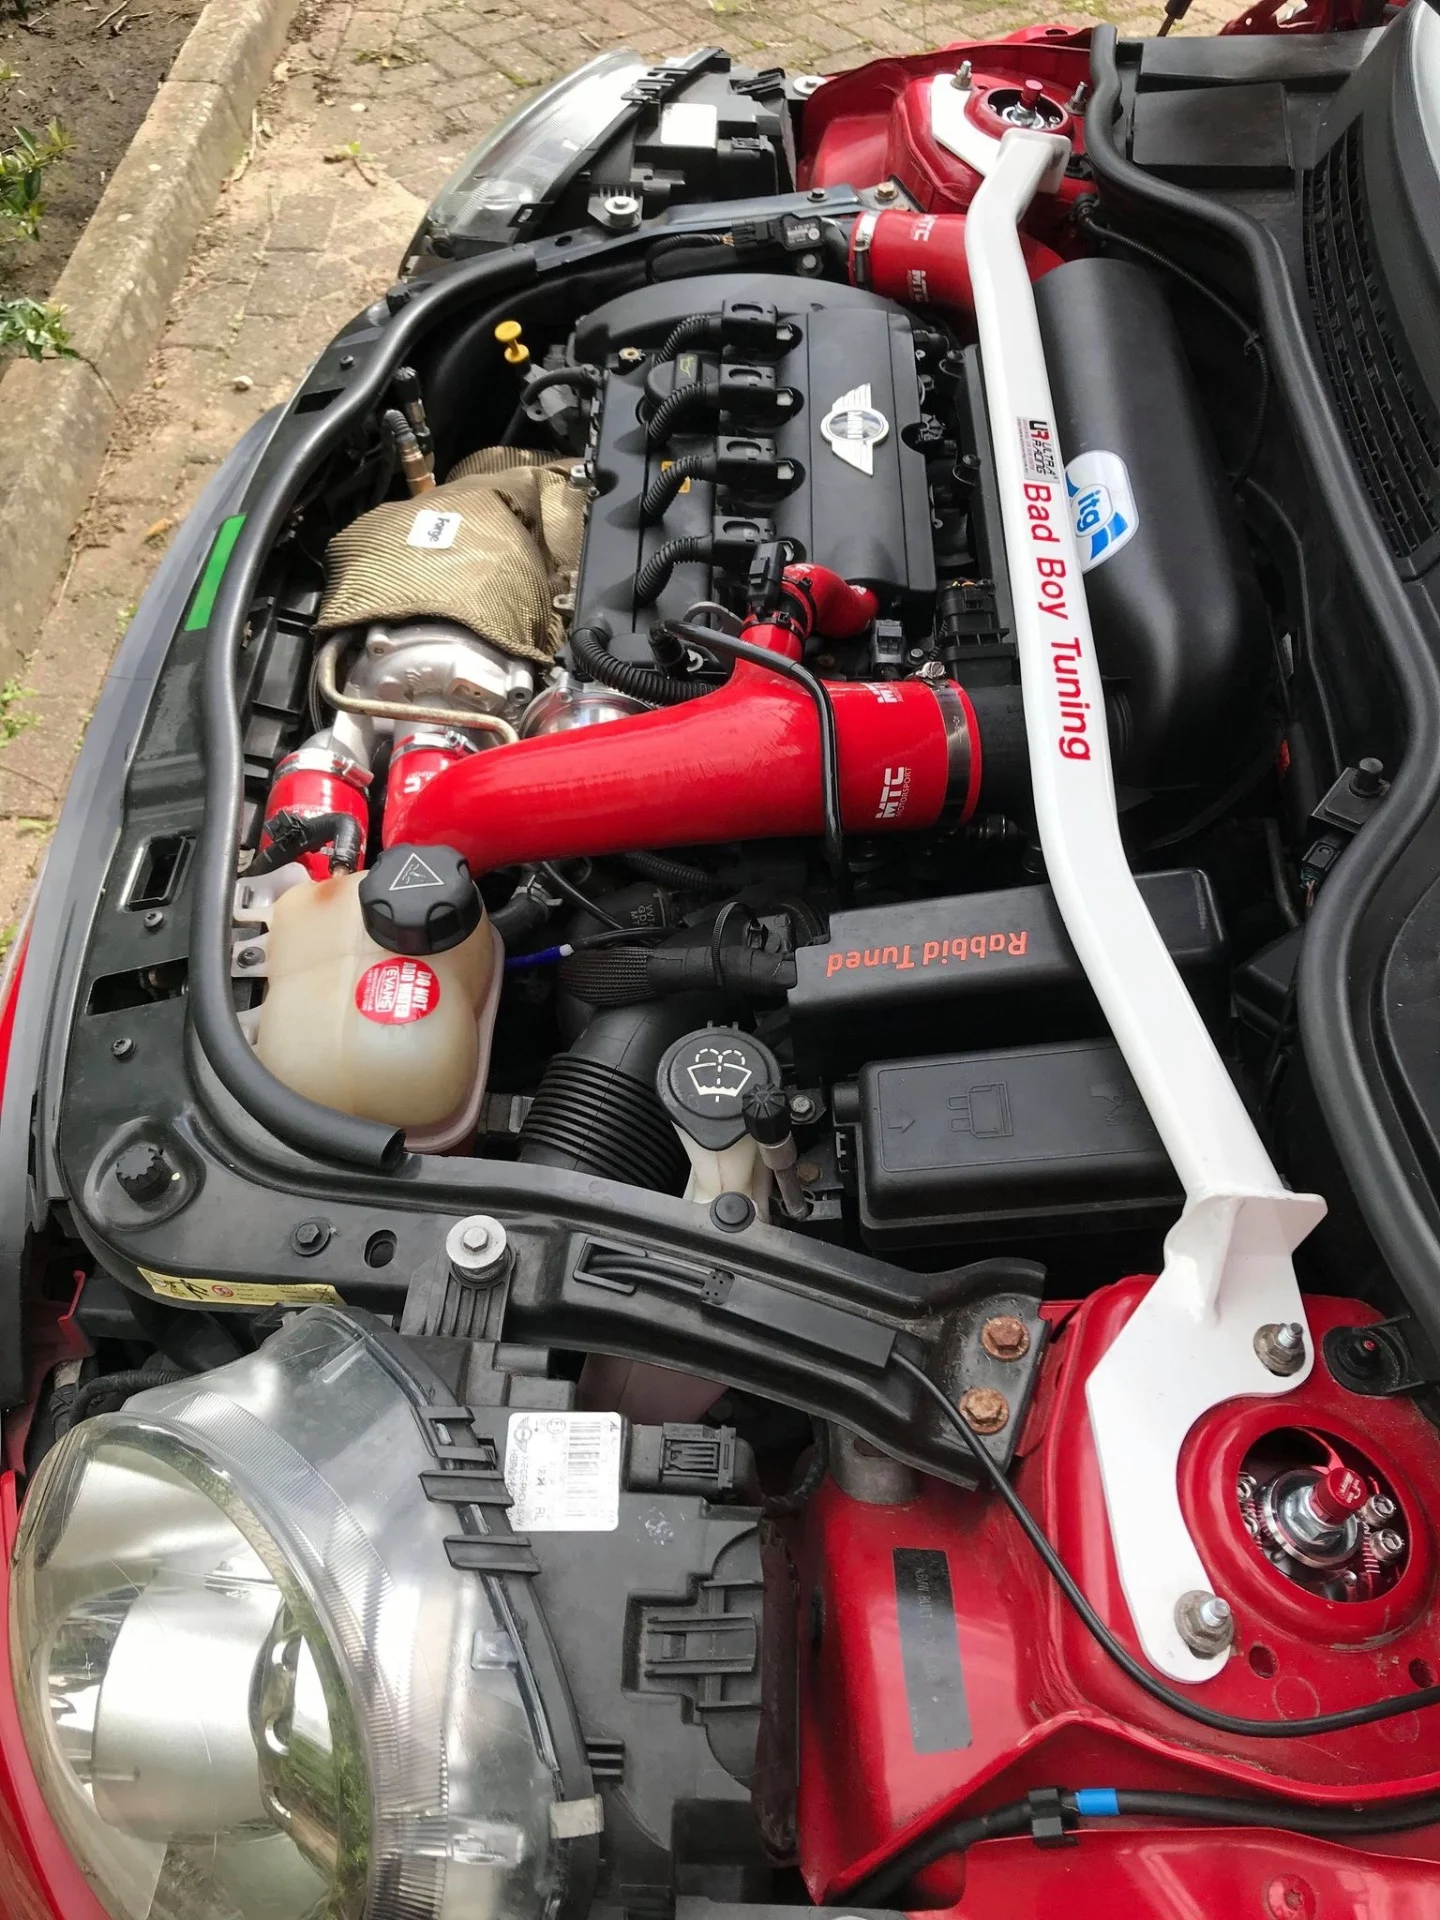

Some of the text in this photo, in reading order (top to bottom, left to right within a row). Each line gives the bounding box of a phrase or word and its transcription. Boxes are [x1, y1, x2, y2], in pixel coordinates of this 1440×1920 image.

[1076, 489, 1101, 532] itg
[1023, 483, 1092, 761] Bad Boy Tuning
[875, 766, 905, 818] MTC
[896, 767, 912, 817] MOTORSPORT
[826, 930, 1028, 978] Rabbid Tuned
[380, 969, 397, 1009] EVANS
[394, 961, 417, 1018] ADD WATER
[412, 970, 432, 1011] DO NOT
